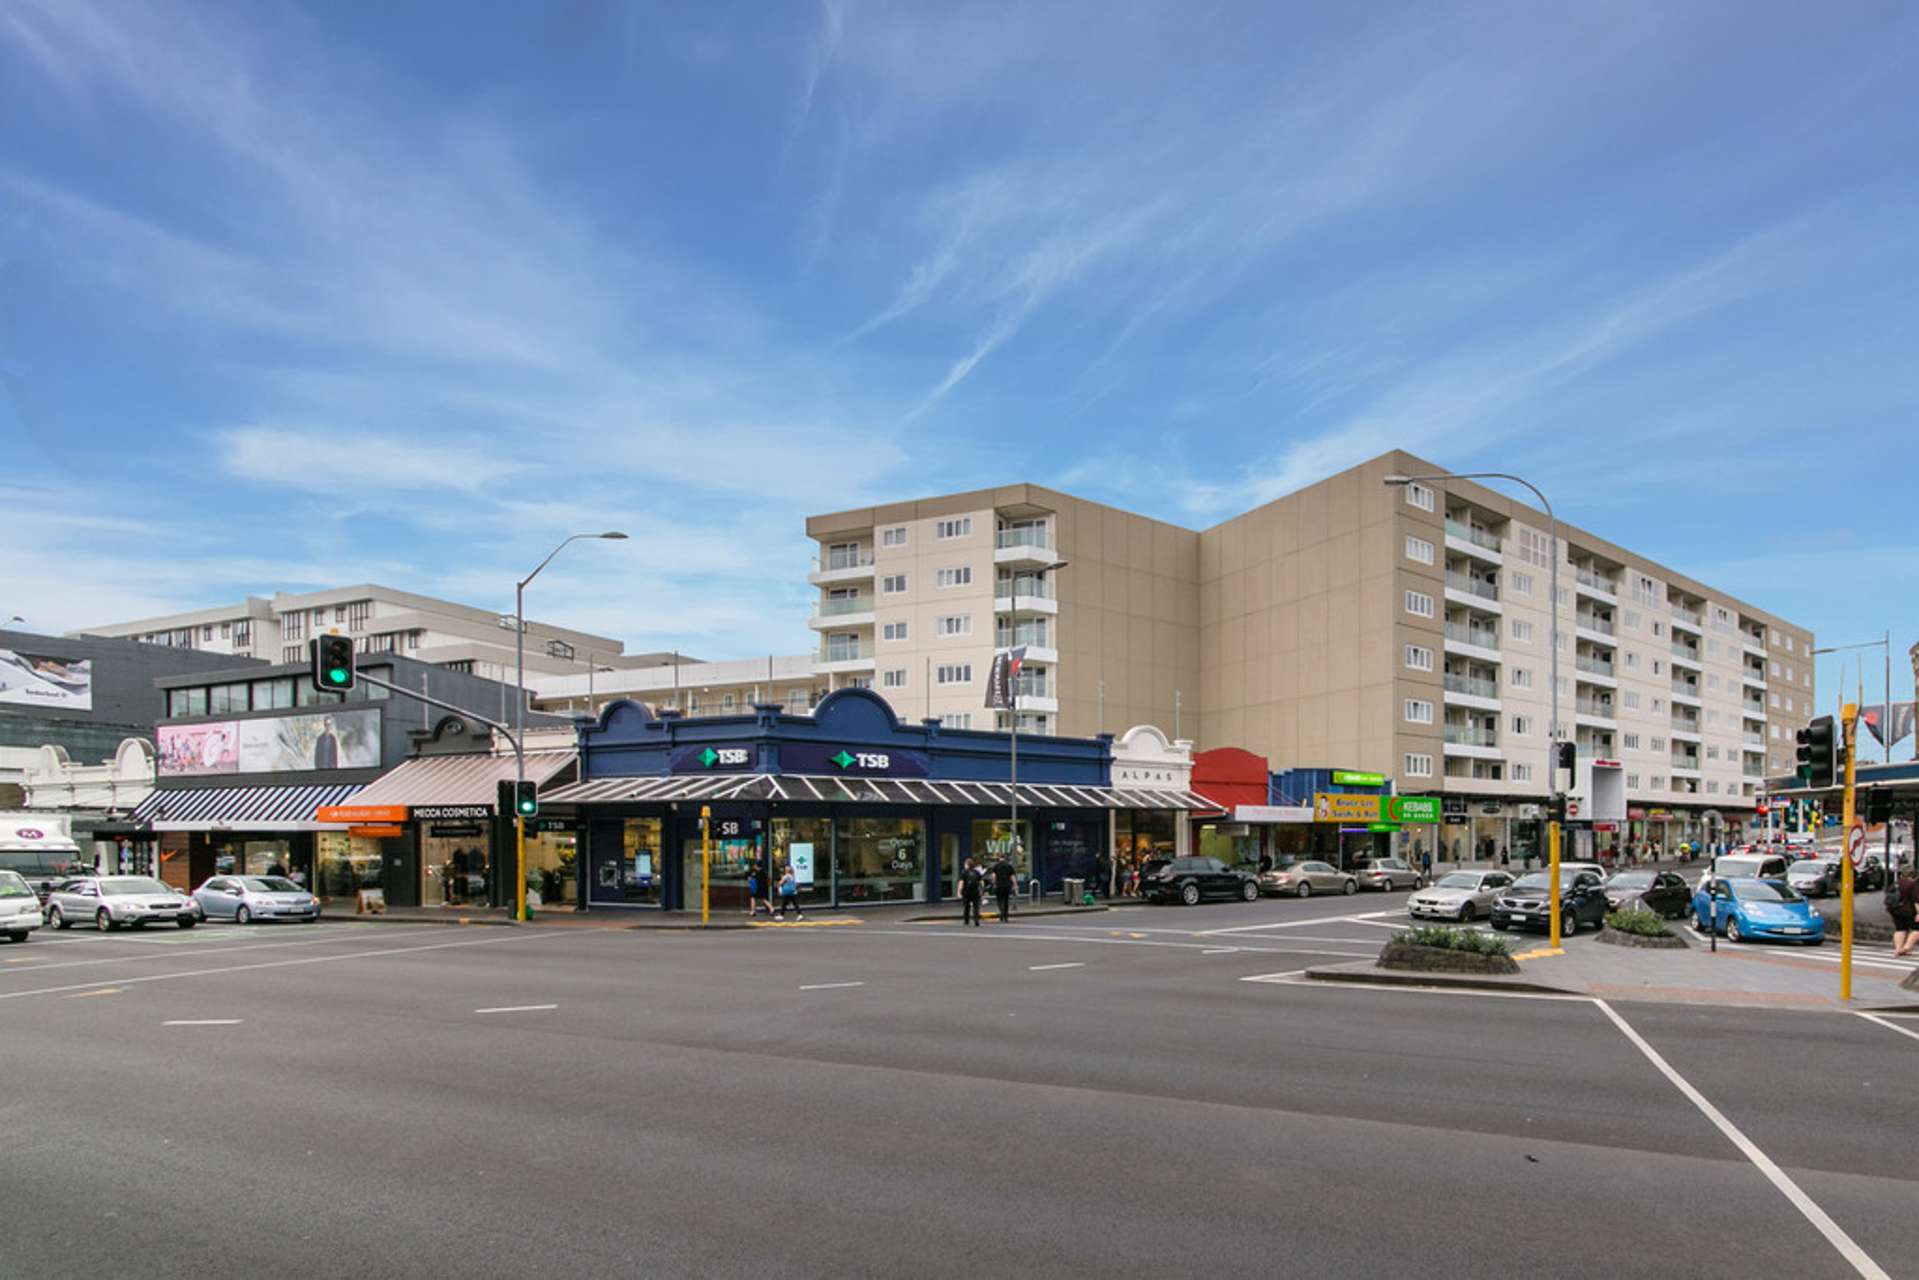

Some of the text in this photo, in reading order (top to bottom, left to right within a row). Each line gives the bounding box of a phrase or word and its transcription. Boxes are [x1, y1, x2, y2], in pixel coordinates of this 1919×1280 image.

[717, 749, 748, 763] TSB
[856, 753, 889, 768] TSB
[1121, 770, 1172, 781] ALPAS
[414, 807, 488, 818] MECCA COSMETICA
[722, 822, 738, 835] SB
[890, 838, 915, 849] Open
[898, 848, 907, 860] 6
